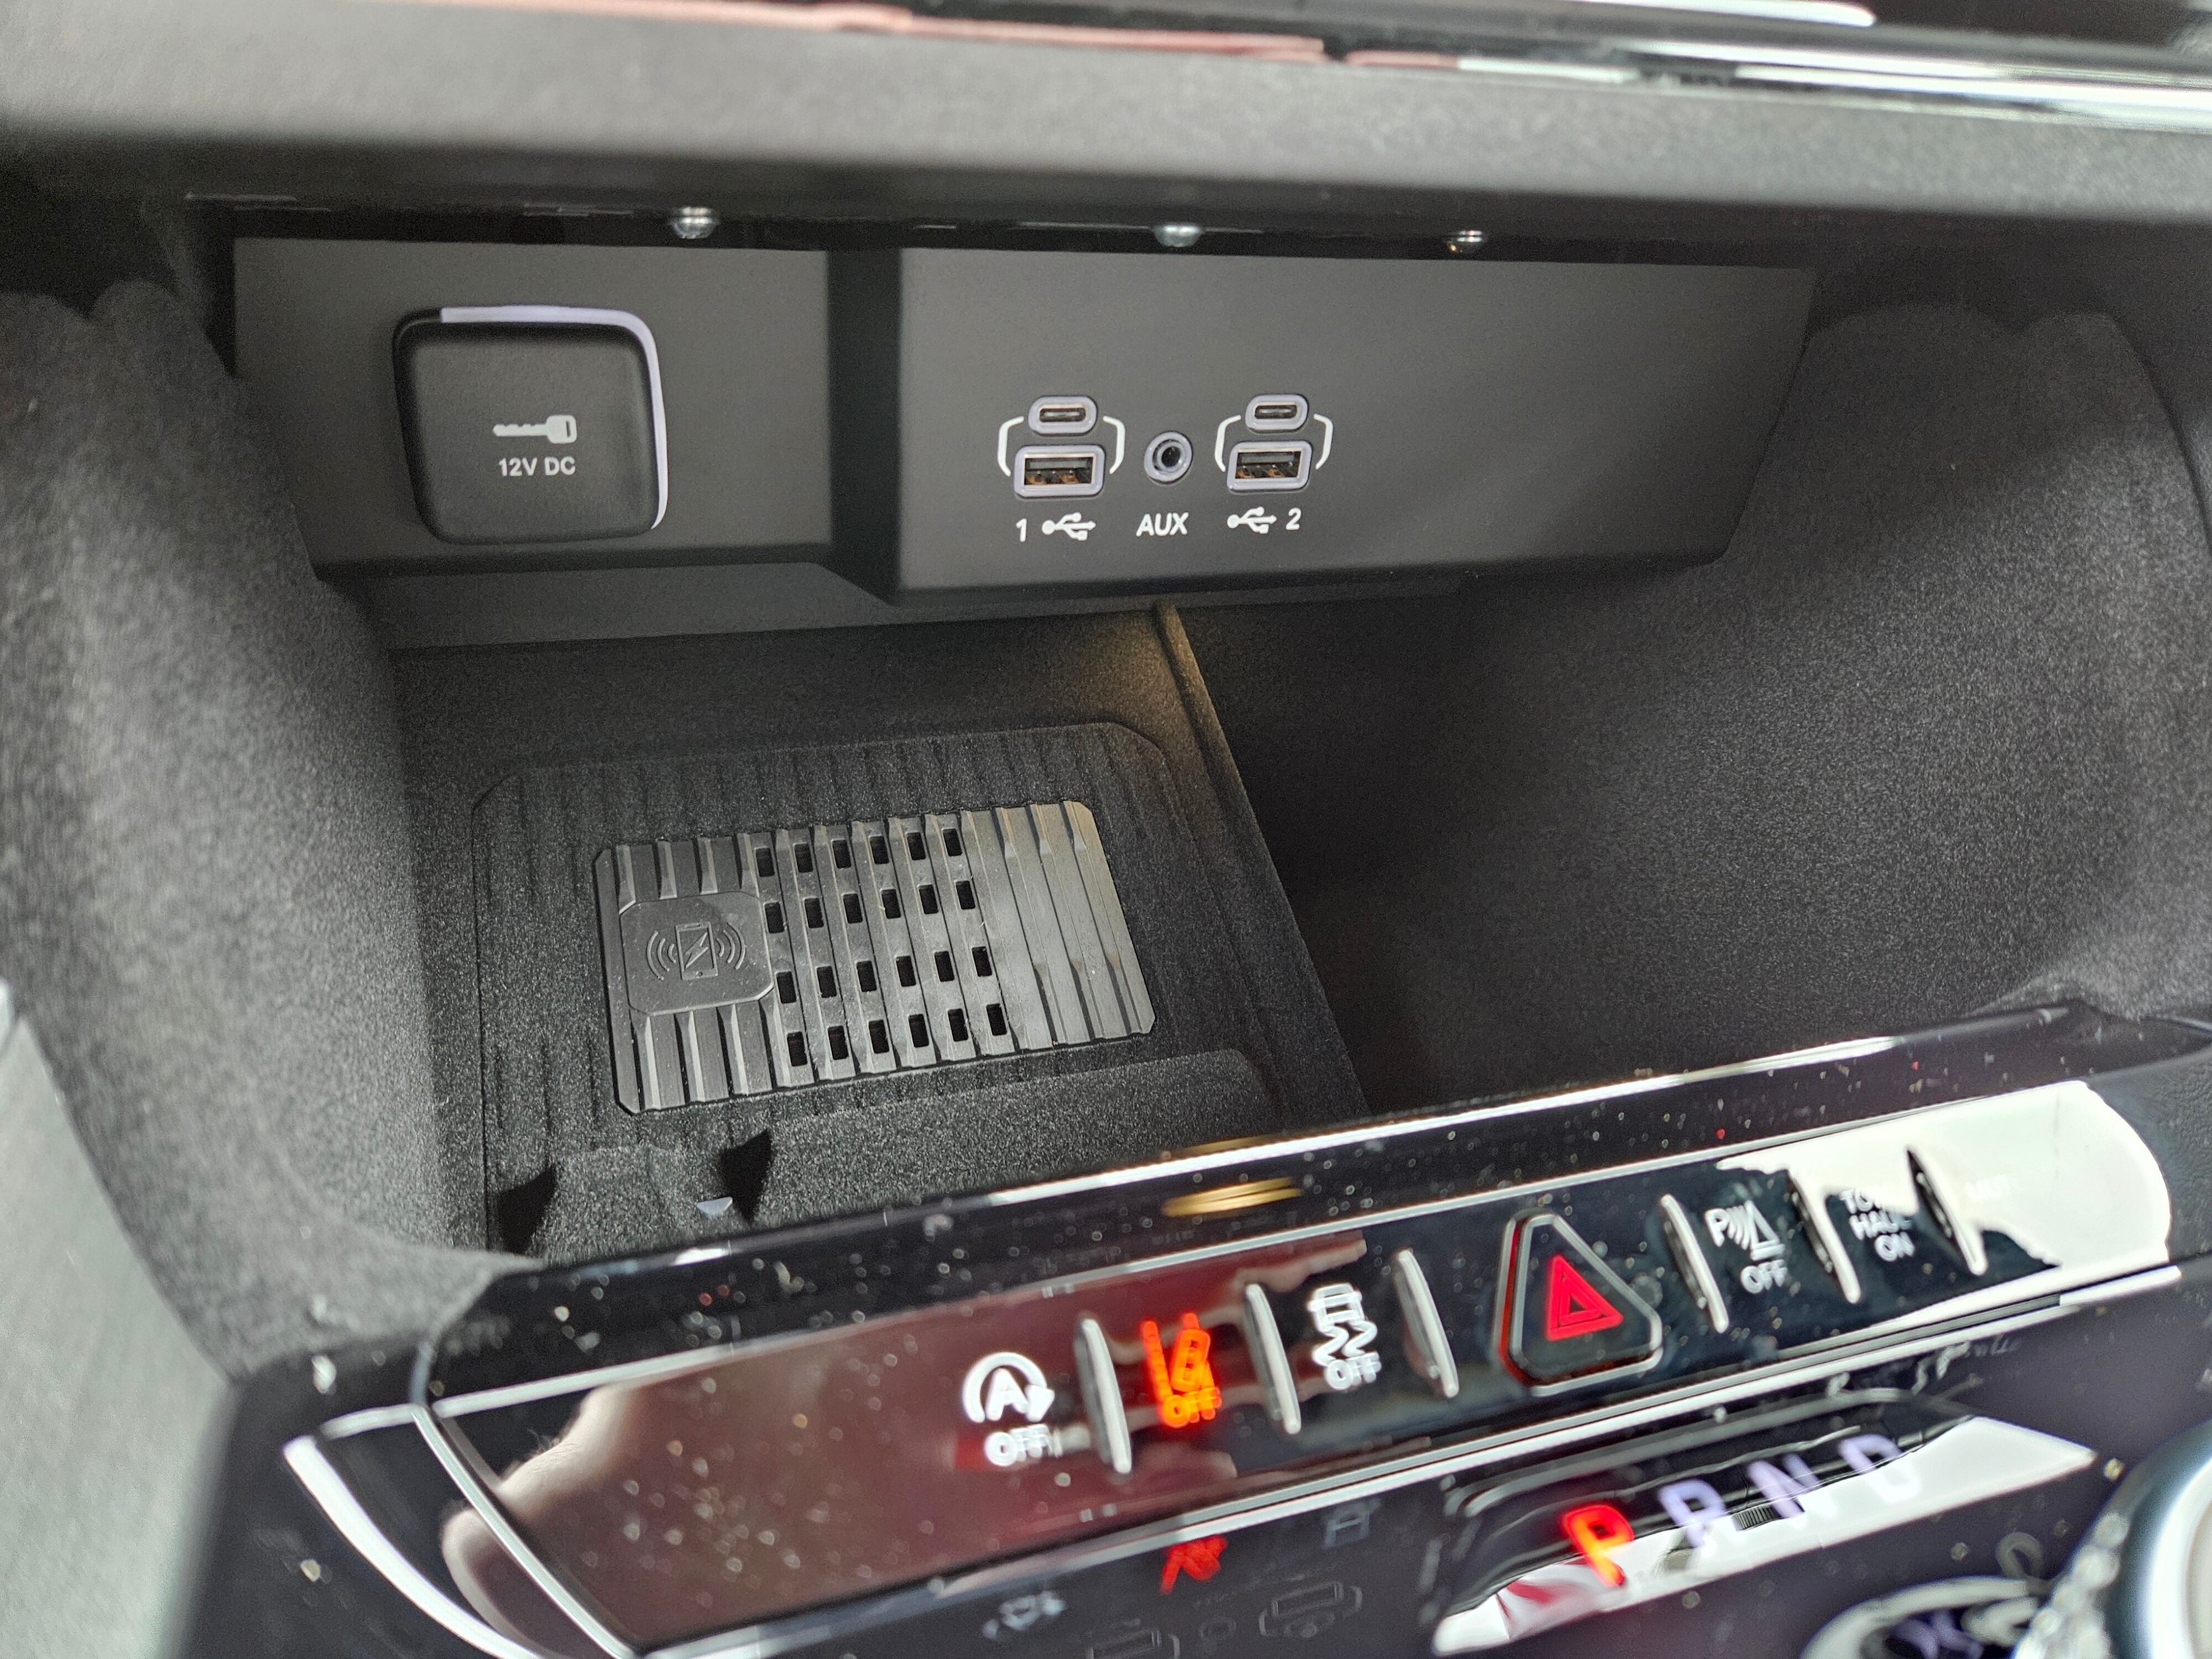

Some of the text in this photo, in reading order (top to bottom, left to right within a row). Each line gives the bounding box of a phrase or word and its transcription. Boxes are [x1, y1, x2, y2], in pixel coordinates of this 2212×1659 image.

[498, 456, 576, 477] 12V DC
[1016, 518, 1027, 542] 1
[1135, 512, 1189, 537] AUX
[1285, 508, 1302, 530] 2
[1839, 1183, 1891, 1214] TO
[1874, 1232, 1915, 1262] ON
[1740, 1259, 1788, 1294] OFF
[1323, 1352, 1382, 1390] OFF
[1160, 1387, 1222, 1428] OFF
[984, 1423, 1048, 1467] OFF
[1562, 1504, 1635, 1587] P
